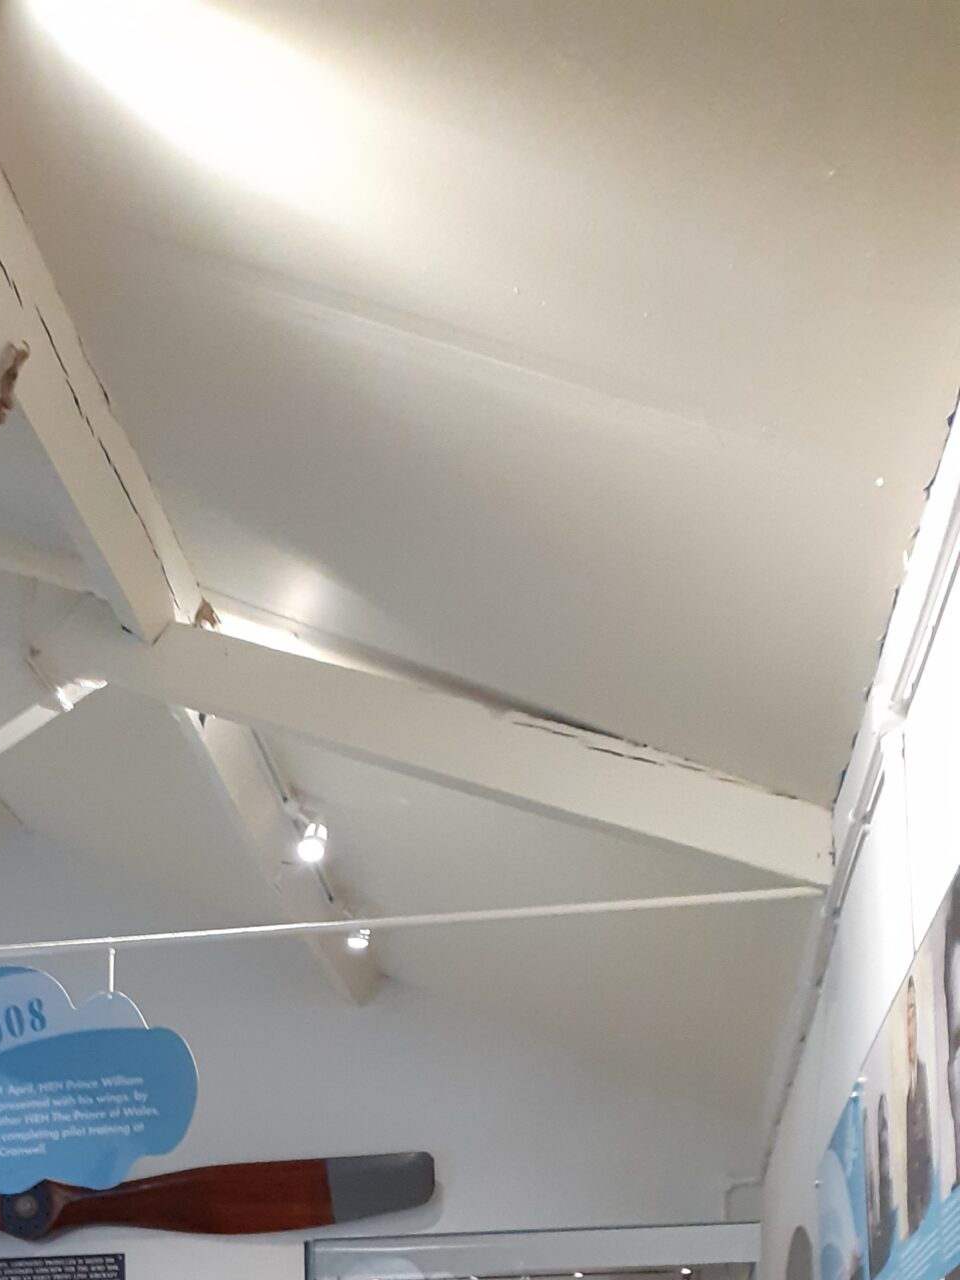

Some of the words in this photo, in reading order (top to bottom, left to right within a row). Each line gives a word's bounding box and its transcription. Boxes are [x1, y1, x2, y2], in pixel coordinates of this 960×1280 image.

[66, 1080, 98, 1090] Prince
[101, 1076, 143, 1088] William
[53, 1096, 75, 1106] with
[78, 1095, 93, 1104] his
[134, 1090, 147, 1102] by
[53, 1112, 71, 1122] The
[74, 1110, 106, 1119] Prince
[110, 1109, 120, 1117] of
[1, 1128, 59, 1142] completing
[62, 1126, 86, 1139] pilot
[89, 1123, 130, 1136] training
[133, 1123, 144, 1132] at
